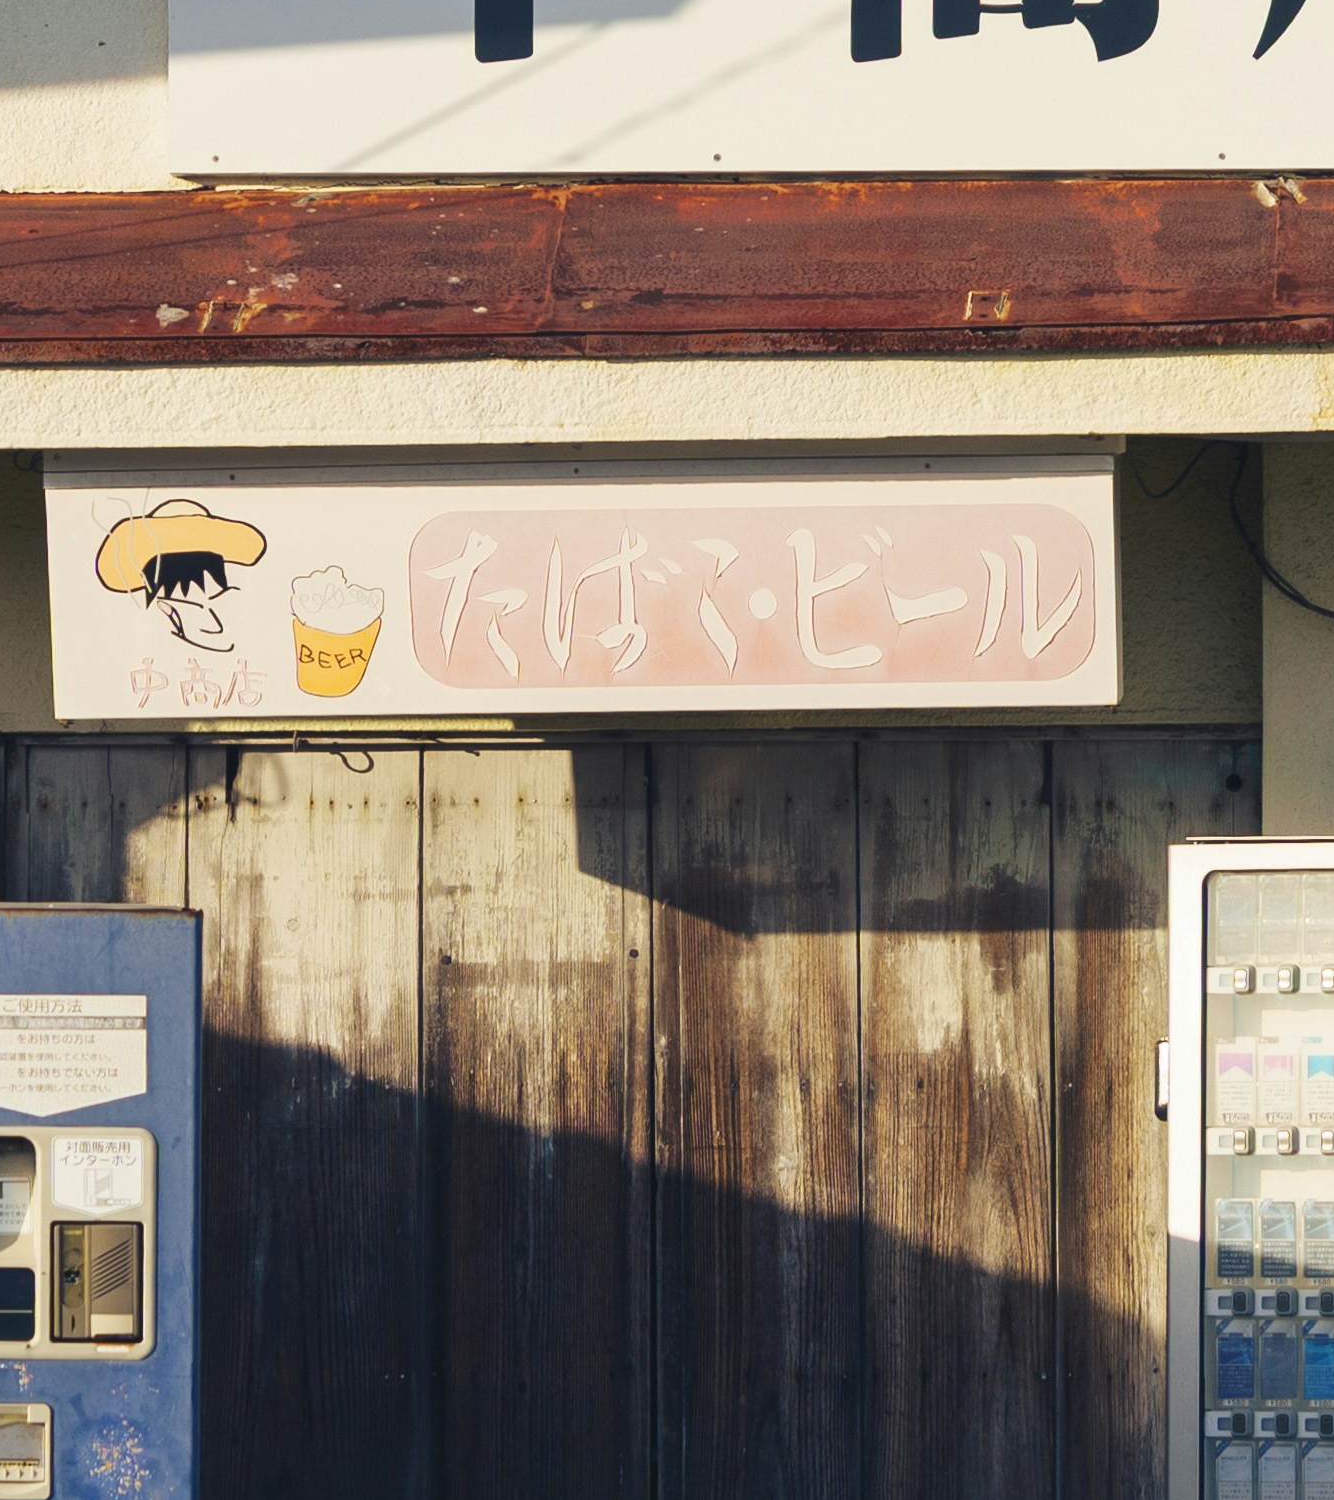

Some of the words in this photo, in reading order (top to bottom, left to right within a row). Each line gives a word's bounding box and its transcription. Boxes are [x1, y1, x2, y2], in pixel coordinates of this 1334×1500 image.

[298, 643, 367, 670] BEER
[3, 998, 83, 1014] ご使用方法
[17, 1034, 95, 1045] をお持ちの方は
[17, 1067, 118, 1078] をお持ちでない方は
[66, 1141, 131, 1154] 対面販売用
[59, 1154, 137, 1166] インターホン
